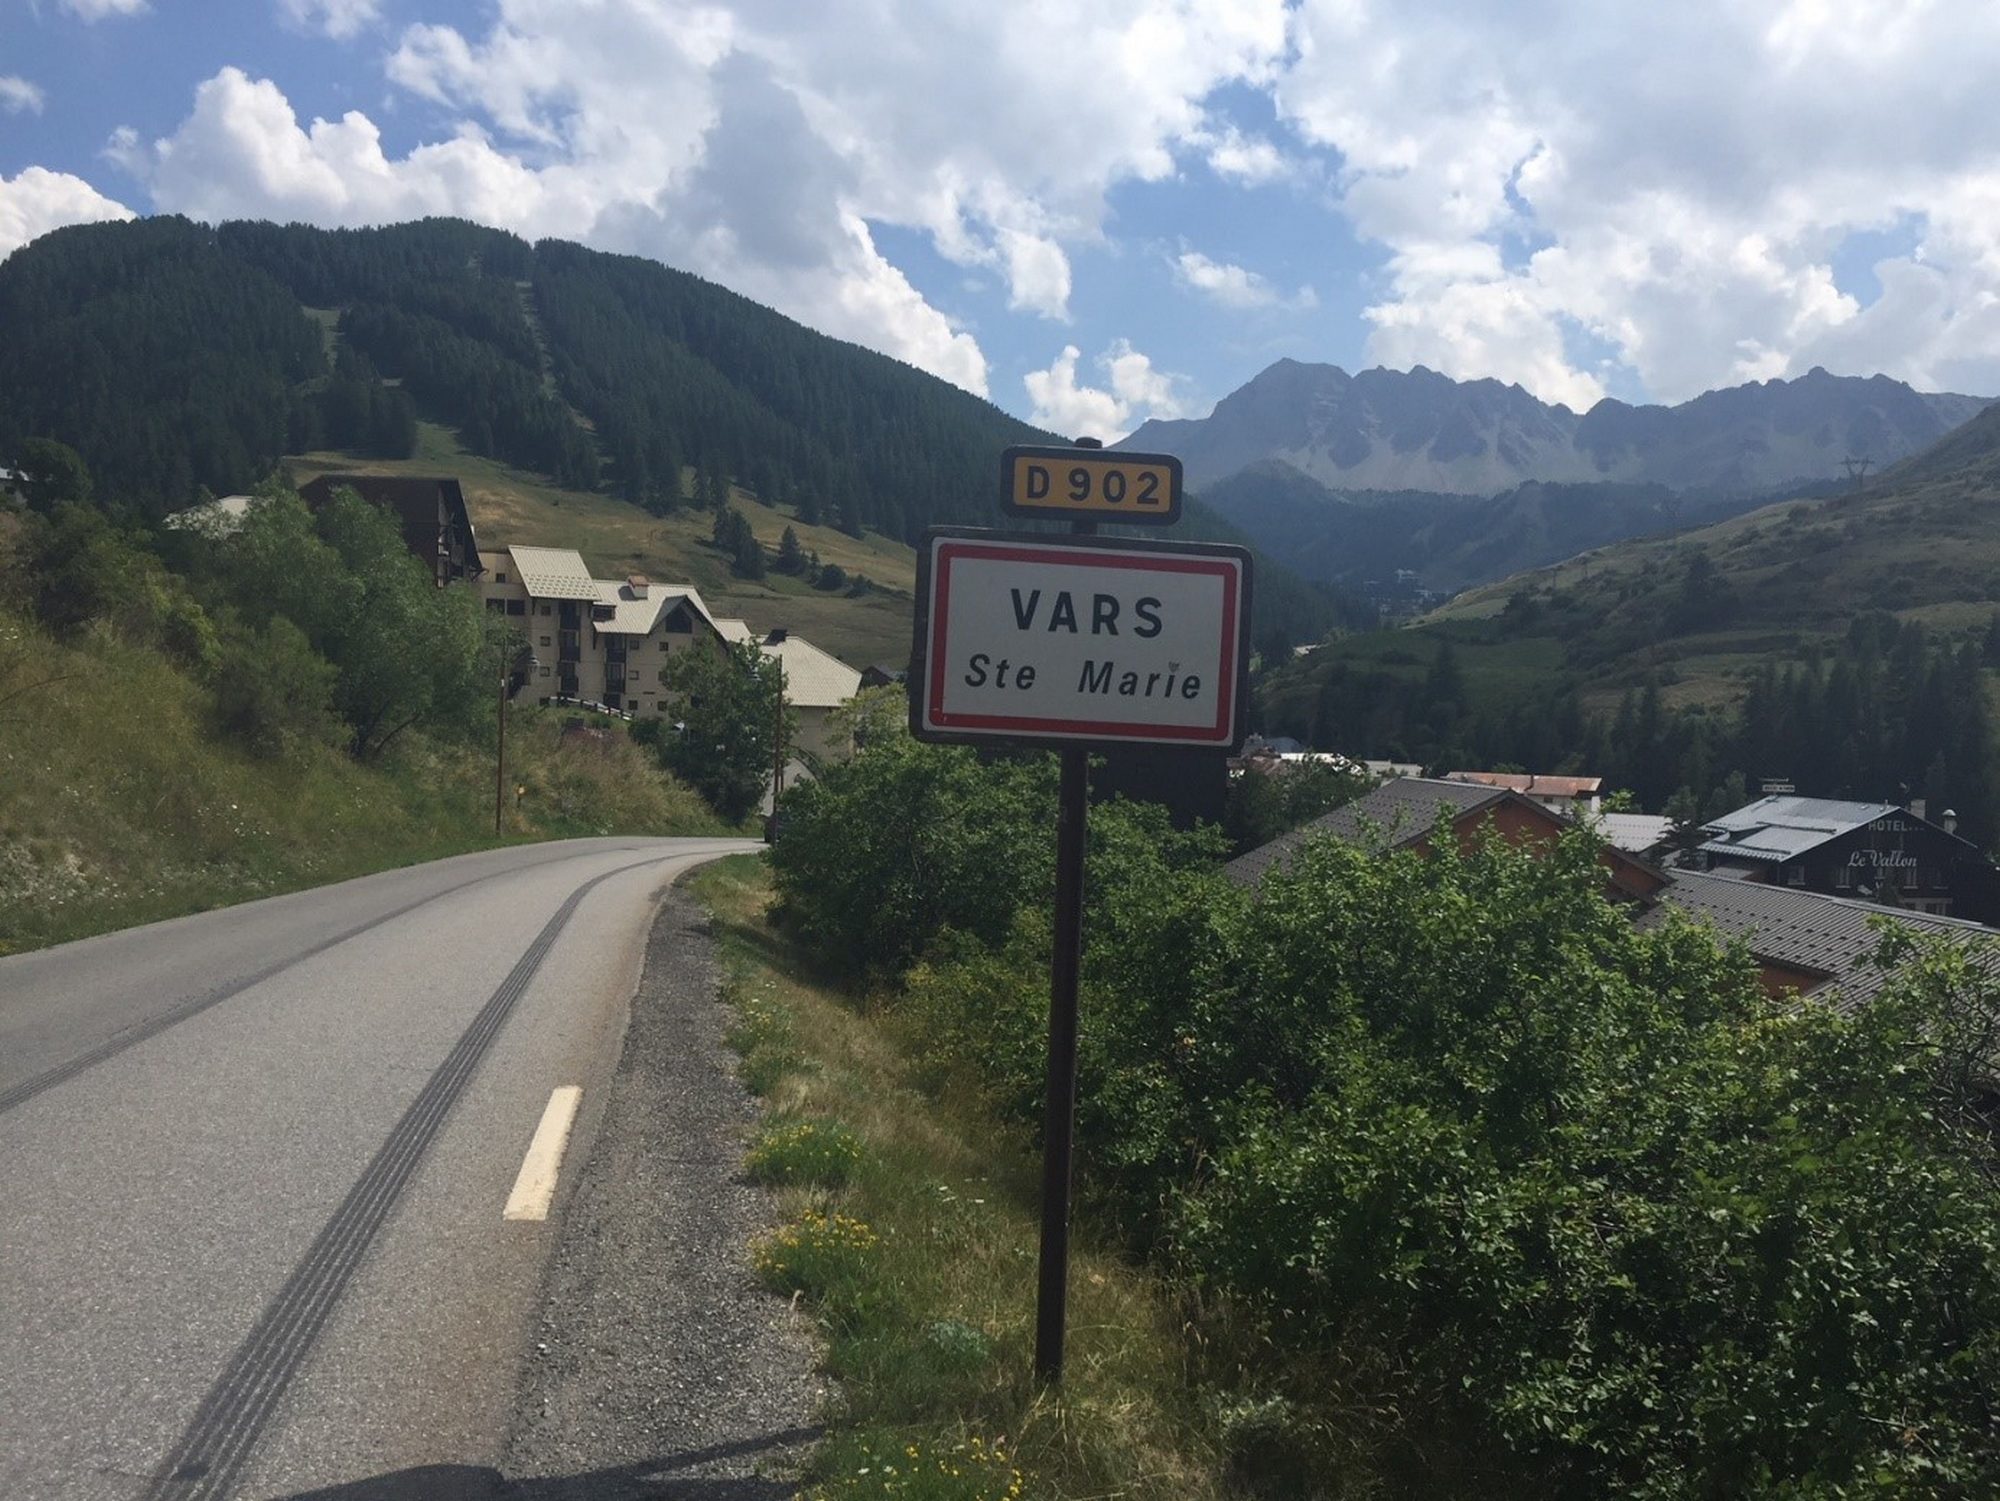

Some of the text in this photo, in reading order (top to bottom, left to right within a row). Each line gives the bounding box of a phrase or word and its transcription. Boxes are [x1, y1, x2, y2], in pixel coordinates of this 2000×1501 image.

[1027, 465, 1160, 505] D 902
[1010, 588, 1163, 638] VARS
[964, 653, 1201, 699] Ste Marie
[1847, 849, 1917, 867] Le Vallon
